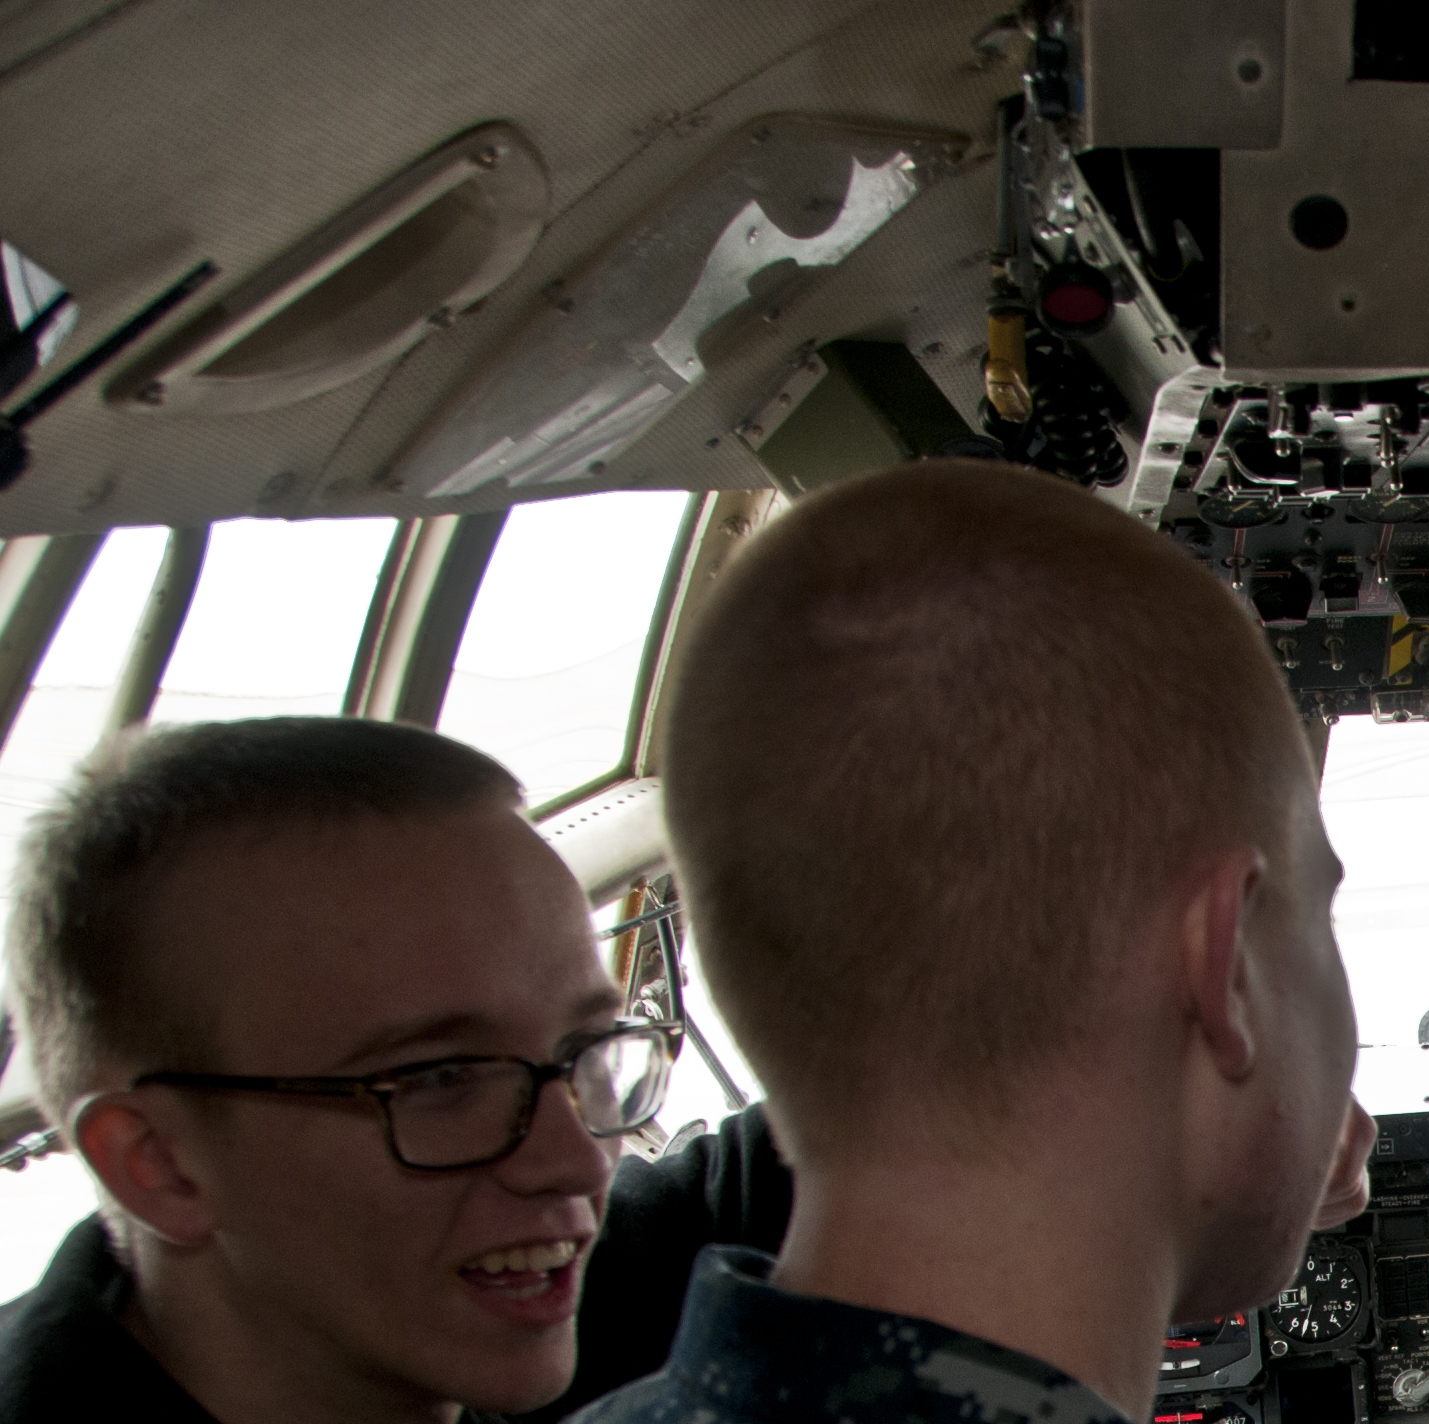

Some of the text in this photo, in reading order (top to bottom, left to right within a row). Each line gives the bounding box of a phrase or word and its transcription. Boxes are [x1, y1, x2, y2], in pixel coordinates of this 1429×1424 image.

[1307, 1260, 1315, 1271] 0
[1315, 1272, 1332, 1282] ALT
[1341, 1278, 1349, 1289] 2
[1344, 1301, 1352, 1312] 3
[1311, 1321, 1319, 1332] 5
